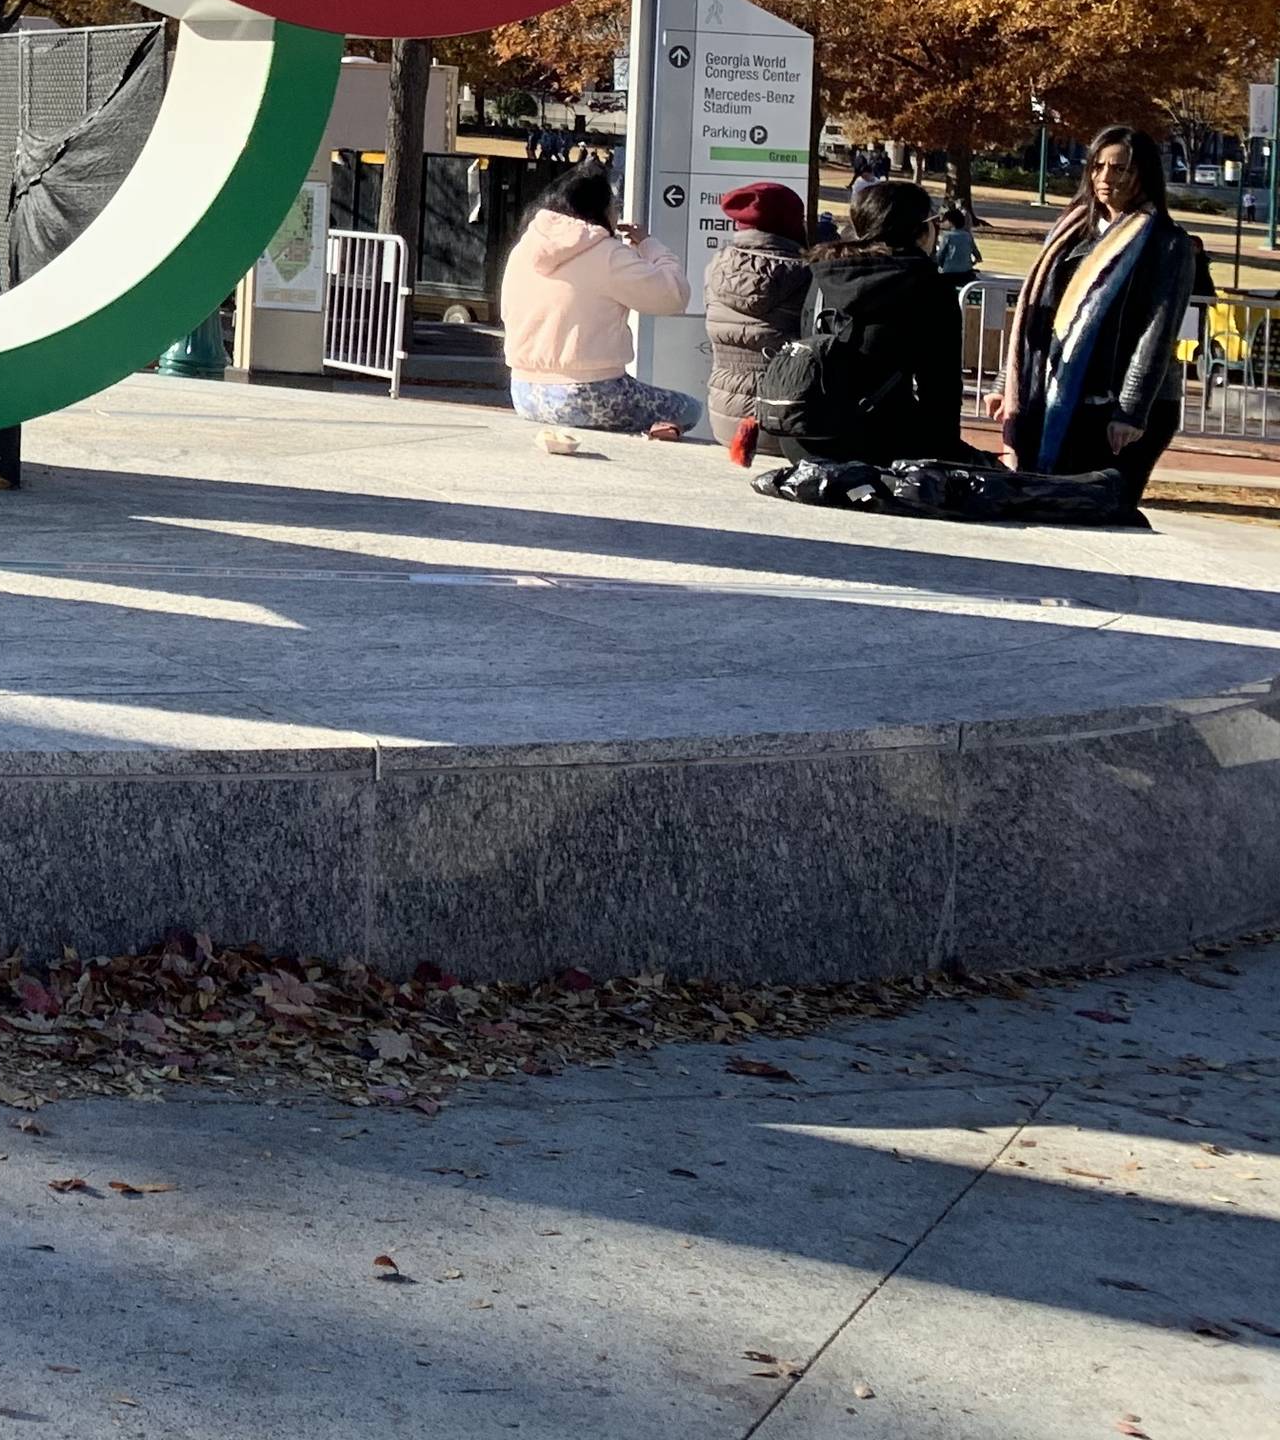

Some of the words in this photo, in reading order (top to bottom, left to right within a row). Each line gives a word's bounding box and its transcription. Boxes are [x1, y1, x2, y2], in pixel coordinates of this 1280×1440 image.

[705, 52, 750, 68] Georgia
[753, 54, 786, 69] World
[705, 65, 759, 81] Congress
[763, 68, 801, 82] Center
[704, 87, 795, 104] Mercedes-Benz
[703, 100, 752, 115] Stadium
[702, 125, 747, 141] Parking
[768, 151, 798, 163] Green
[700, 192, 725, 205] Phil
